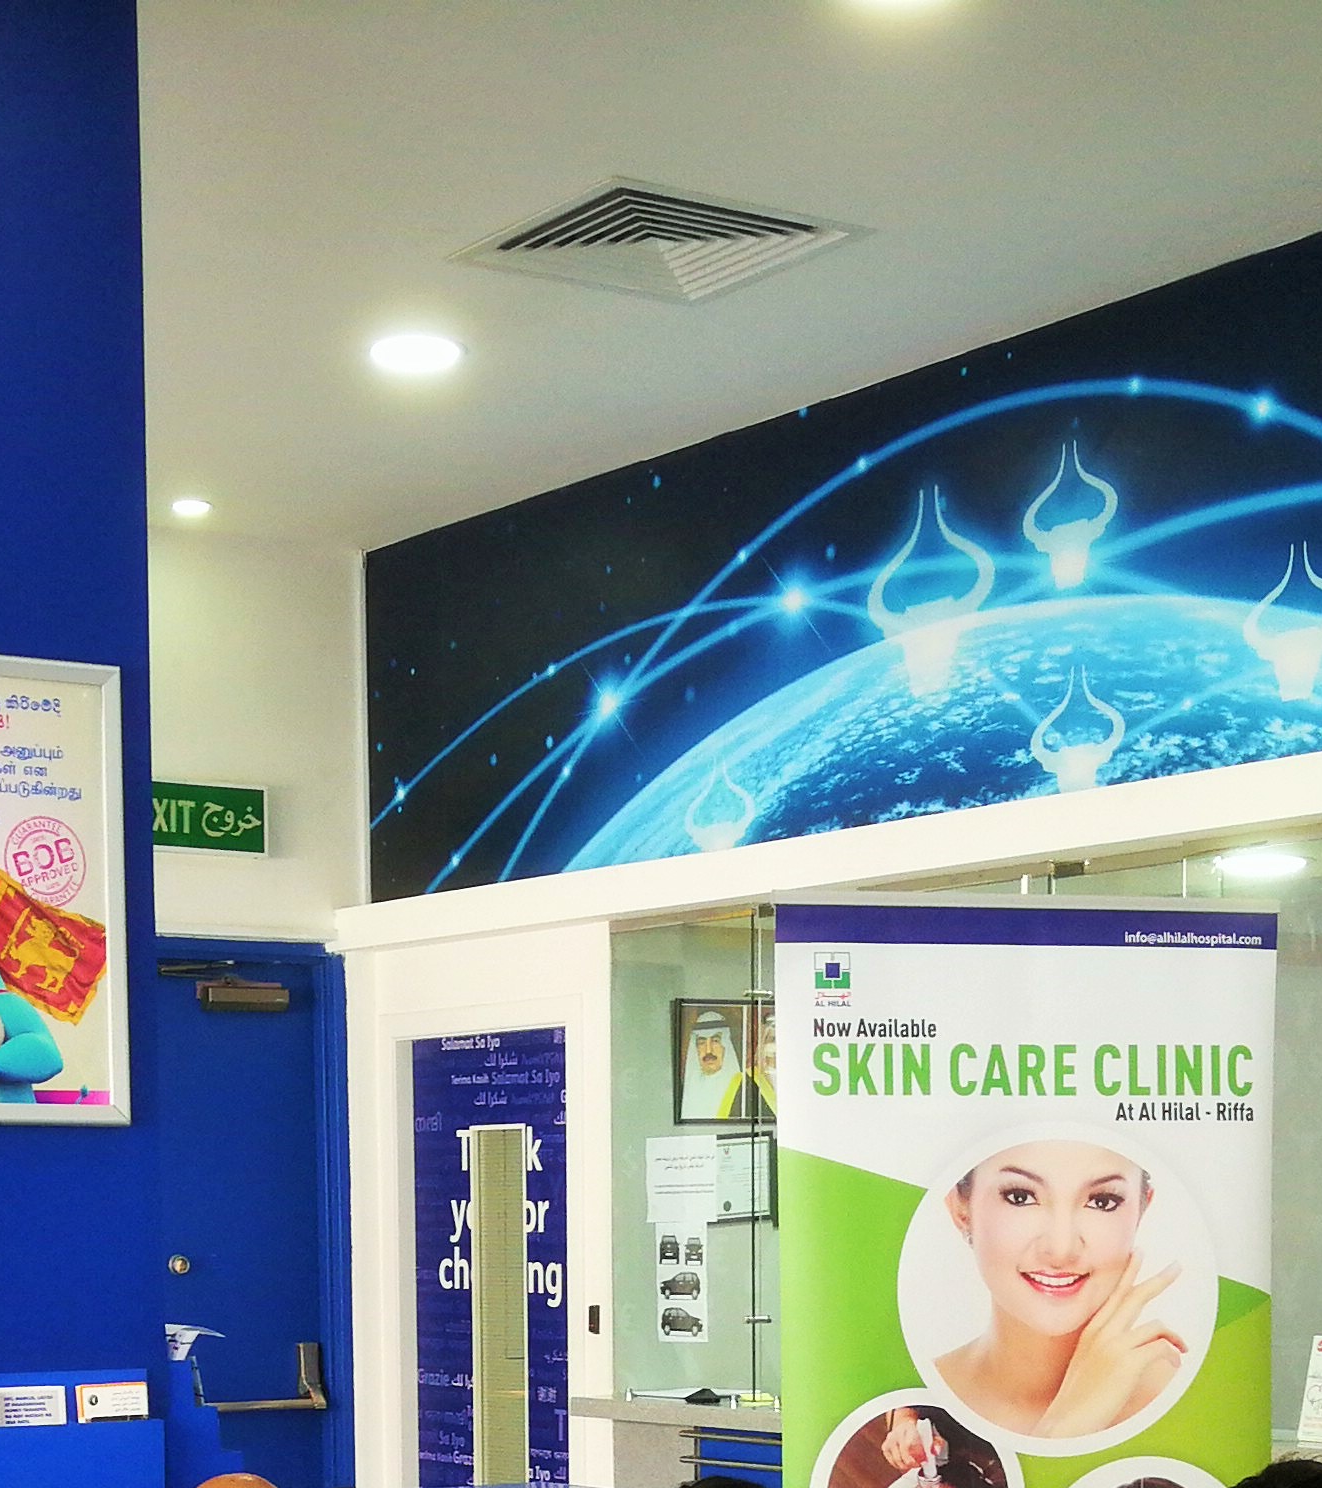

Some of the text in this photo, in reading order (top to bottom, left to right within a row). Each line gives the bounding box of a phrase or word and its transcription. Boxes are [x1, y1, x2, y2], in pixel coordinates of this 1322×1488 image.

[152, 798, 195, 834] XIT
[201, 801, 262, 838] خروج
[12, 838, 75, 877] BOB
[20, 862, 78, 888] APPROVED
[1123, 930, 1263, 947] info@alhilalhospital.com
[813, 1018, 937, 1038] Now Available
[812, 1042, 1254, 1098] SKIN CARE CLINIC
[1115, 1102, 1134, 1121] At
[1138, 1102, 1156, 1121] Al
[1161, 1102, 1200, 1122] Hilal
[1216, 1102, 1255, 1122] Riffa
